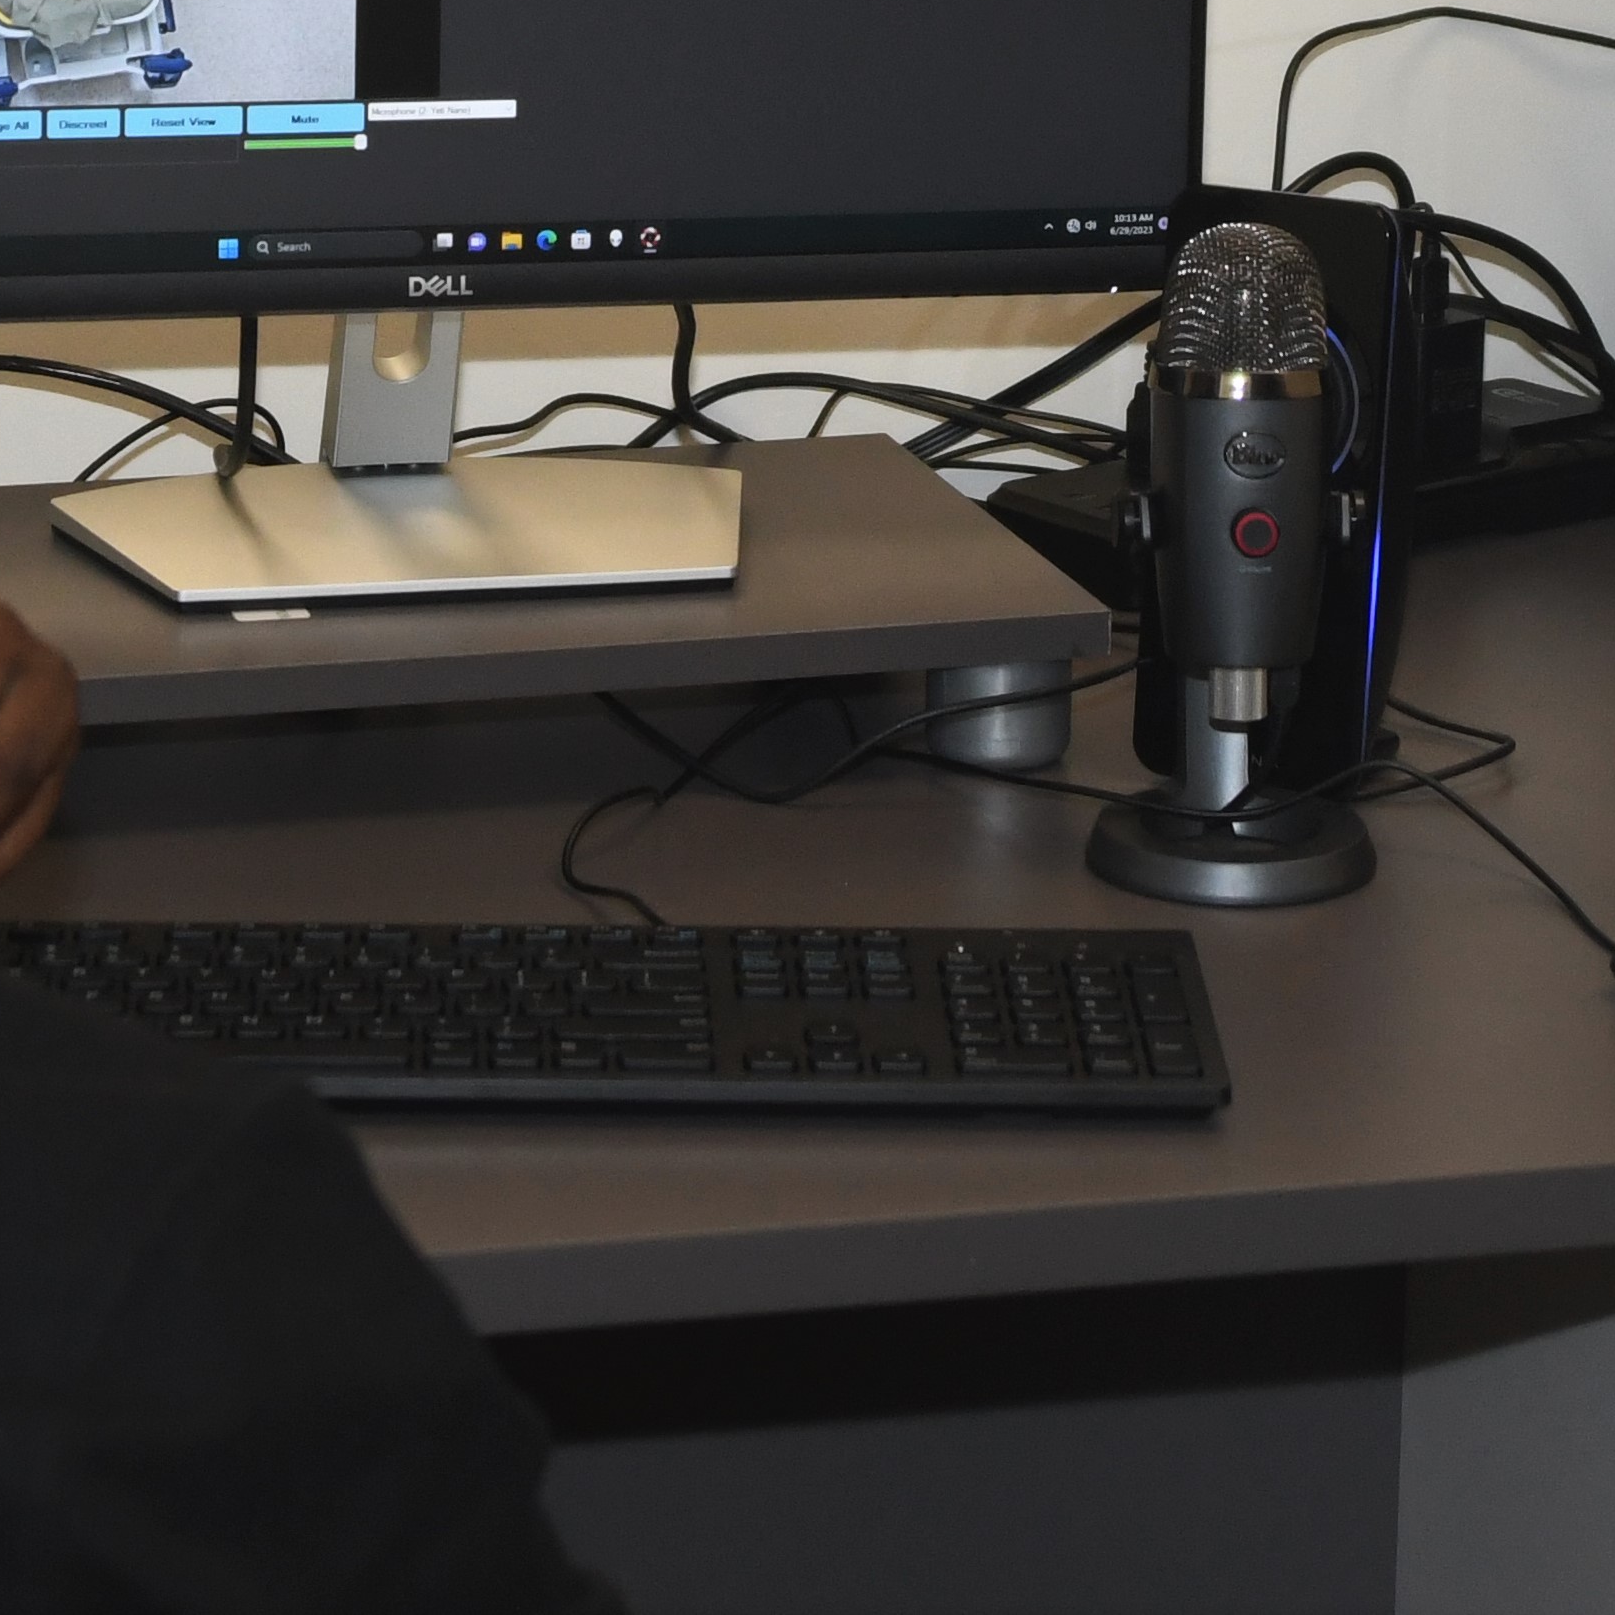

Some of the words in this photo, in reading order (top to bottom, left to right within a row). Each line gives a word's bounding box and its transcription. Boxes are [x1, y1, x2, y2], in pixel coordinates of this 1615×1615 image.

[14, 120, 30, 131] All
[150, 116, 186, 129] Reset
[188, 115, 217, 127] View
[291, 113, 320, 126] Mute
[1138, 213, 1154, 222] AM
[276, 239, 312, 254] Search
[408, 274, 474, 298] DELL
